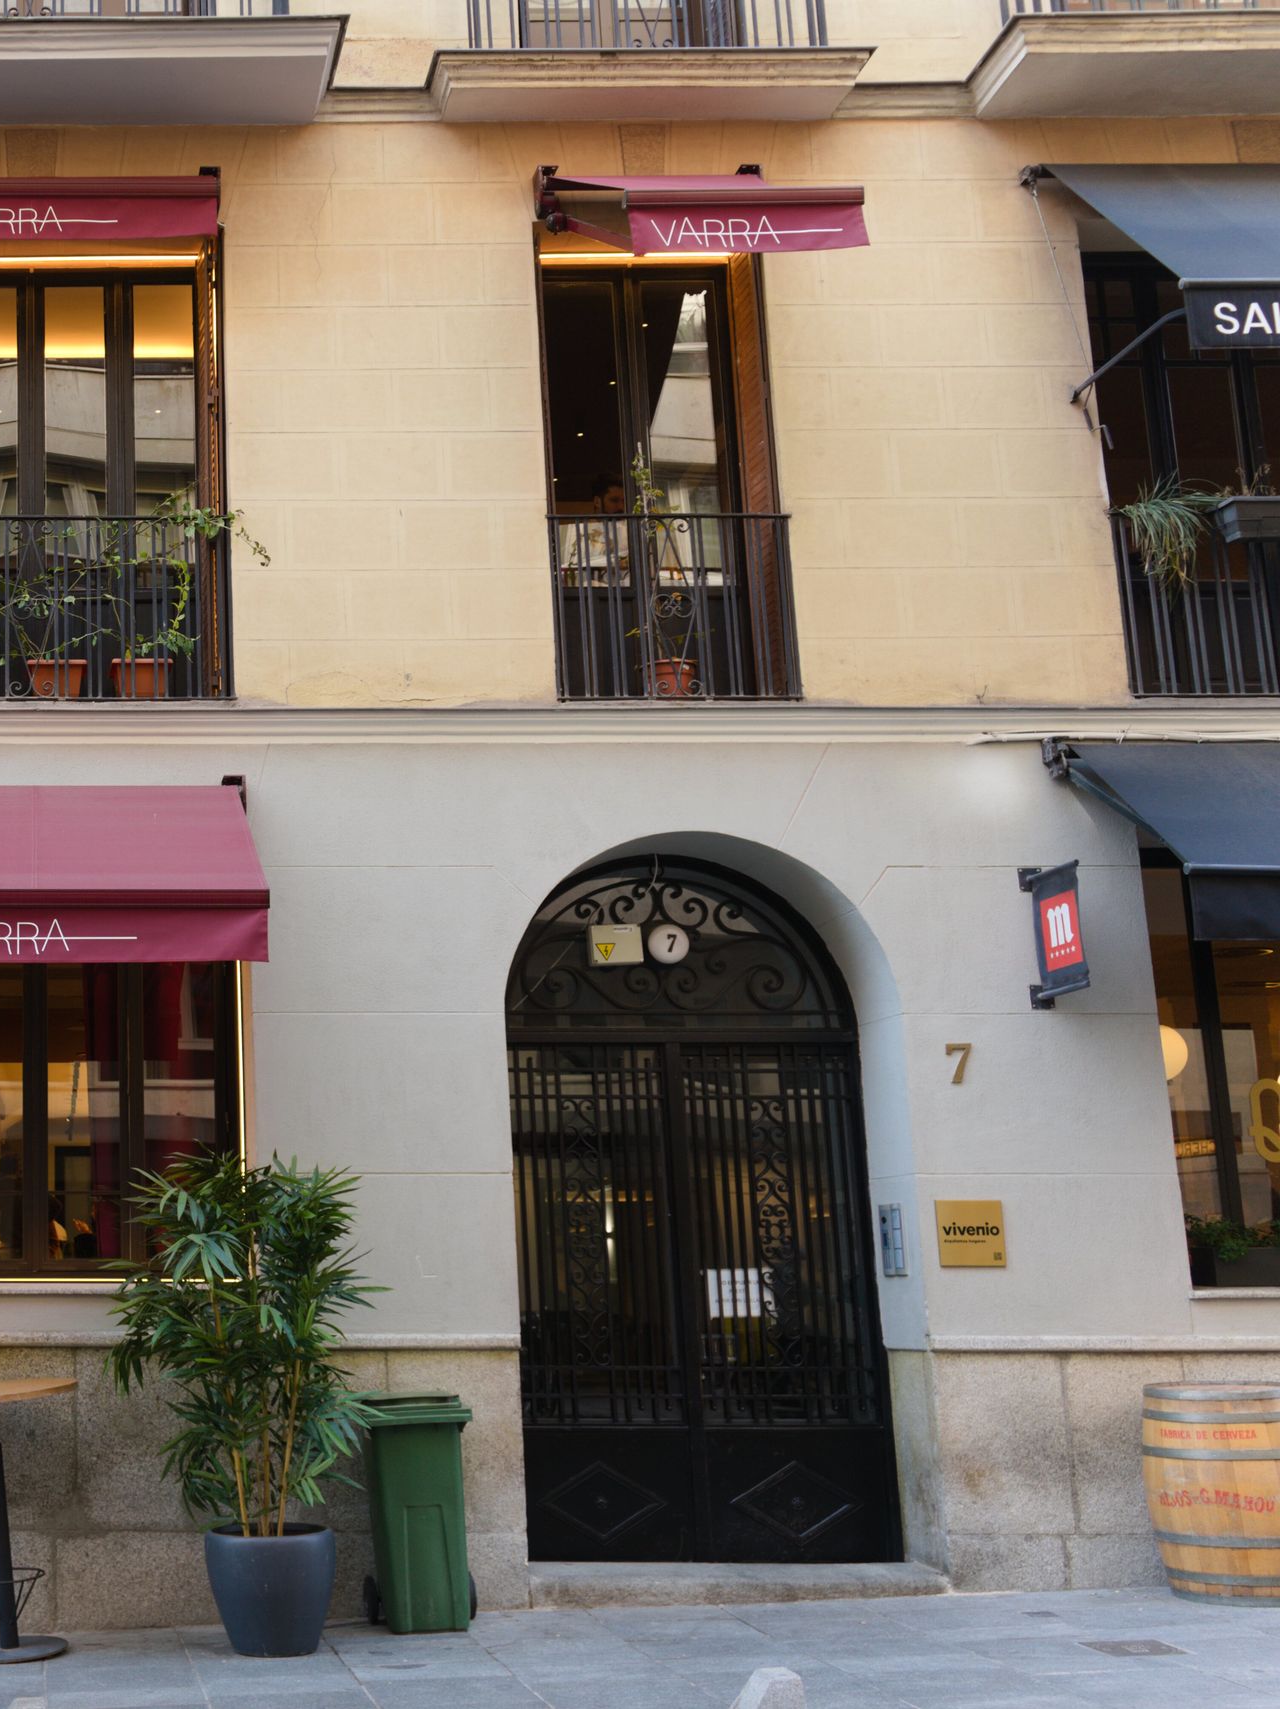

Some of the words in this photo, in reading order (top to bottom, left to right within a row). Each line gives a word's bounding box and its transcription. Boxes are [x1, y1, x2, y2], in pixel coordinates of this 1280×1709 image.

[650, 216, 781, 248] VARRA
[666, 933, 677, 953] 7
[945, 1043, 972, 1084] 7
[942, 1222, 1000, 1236] vivenio
[1196, 1430, 1208, 1440] DE
[1212, 1430, 1257, 1440] CERVEZA
